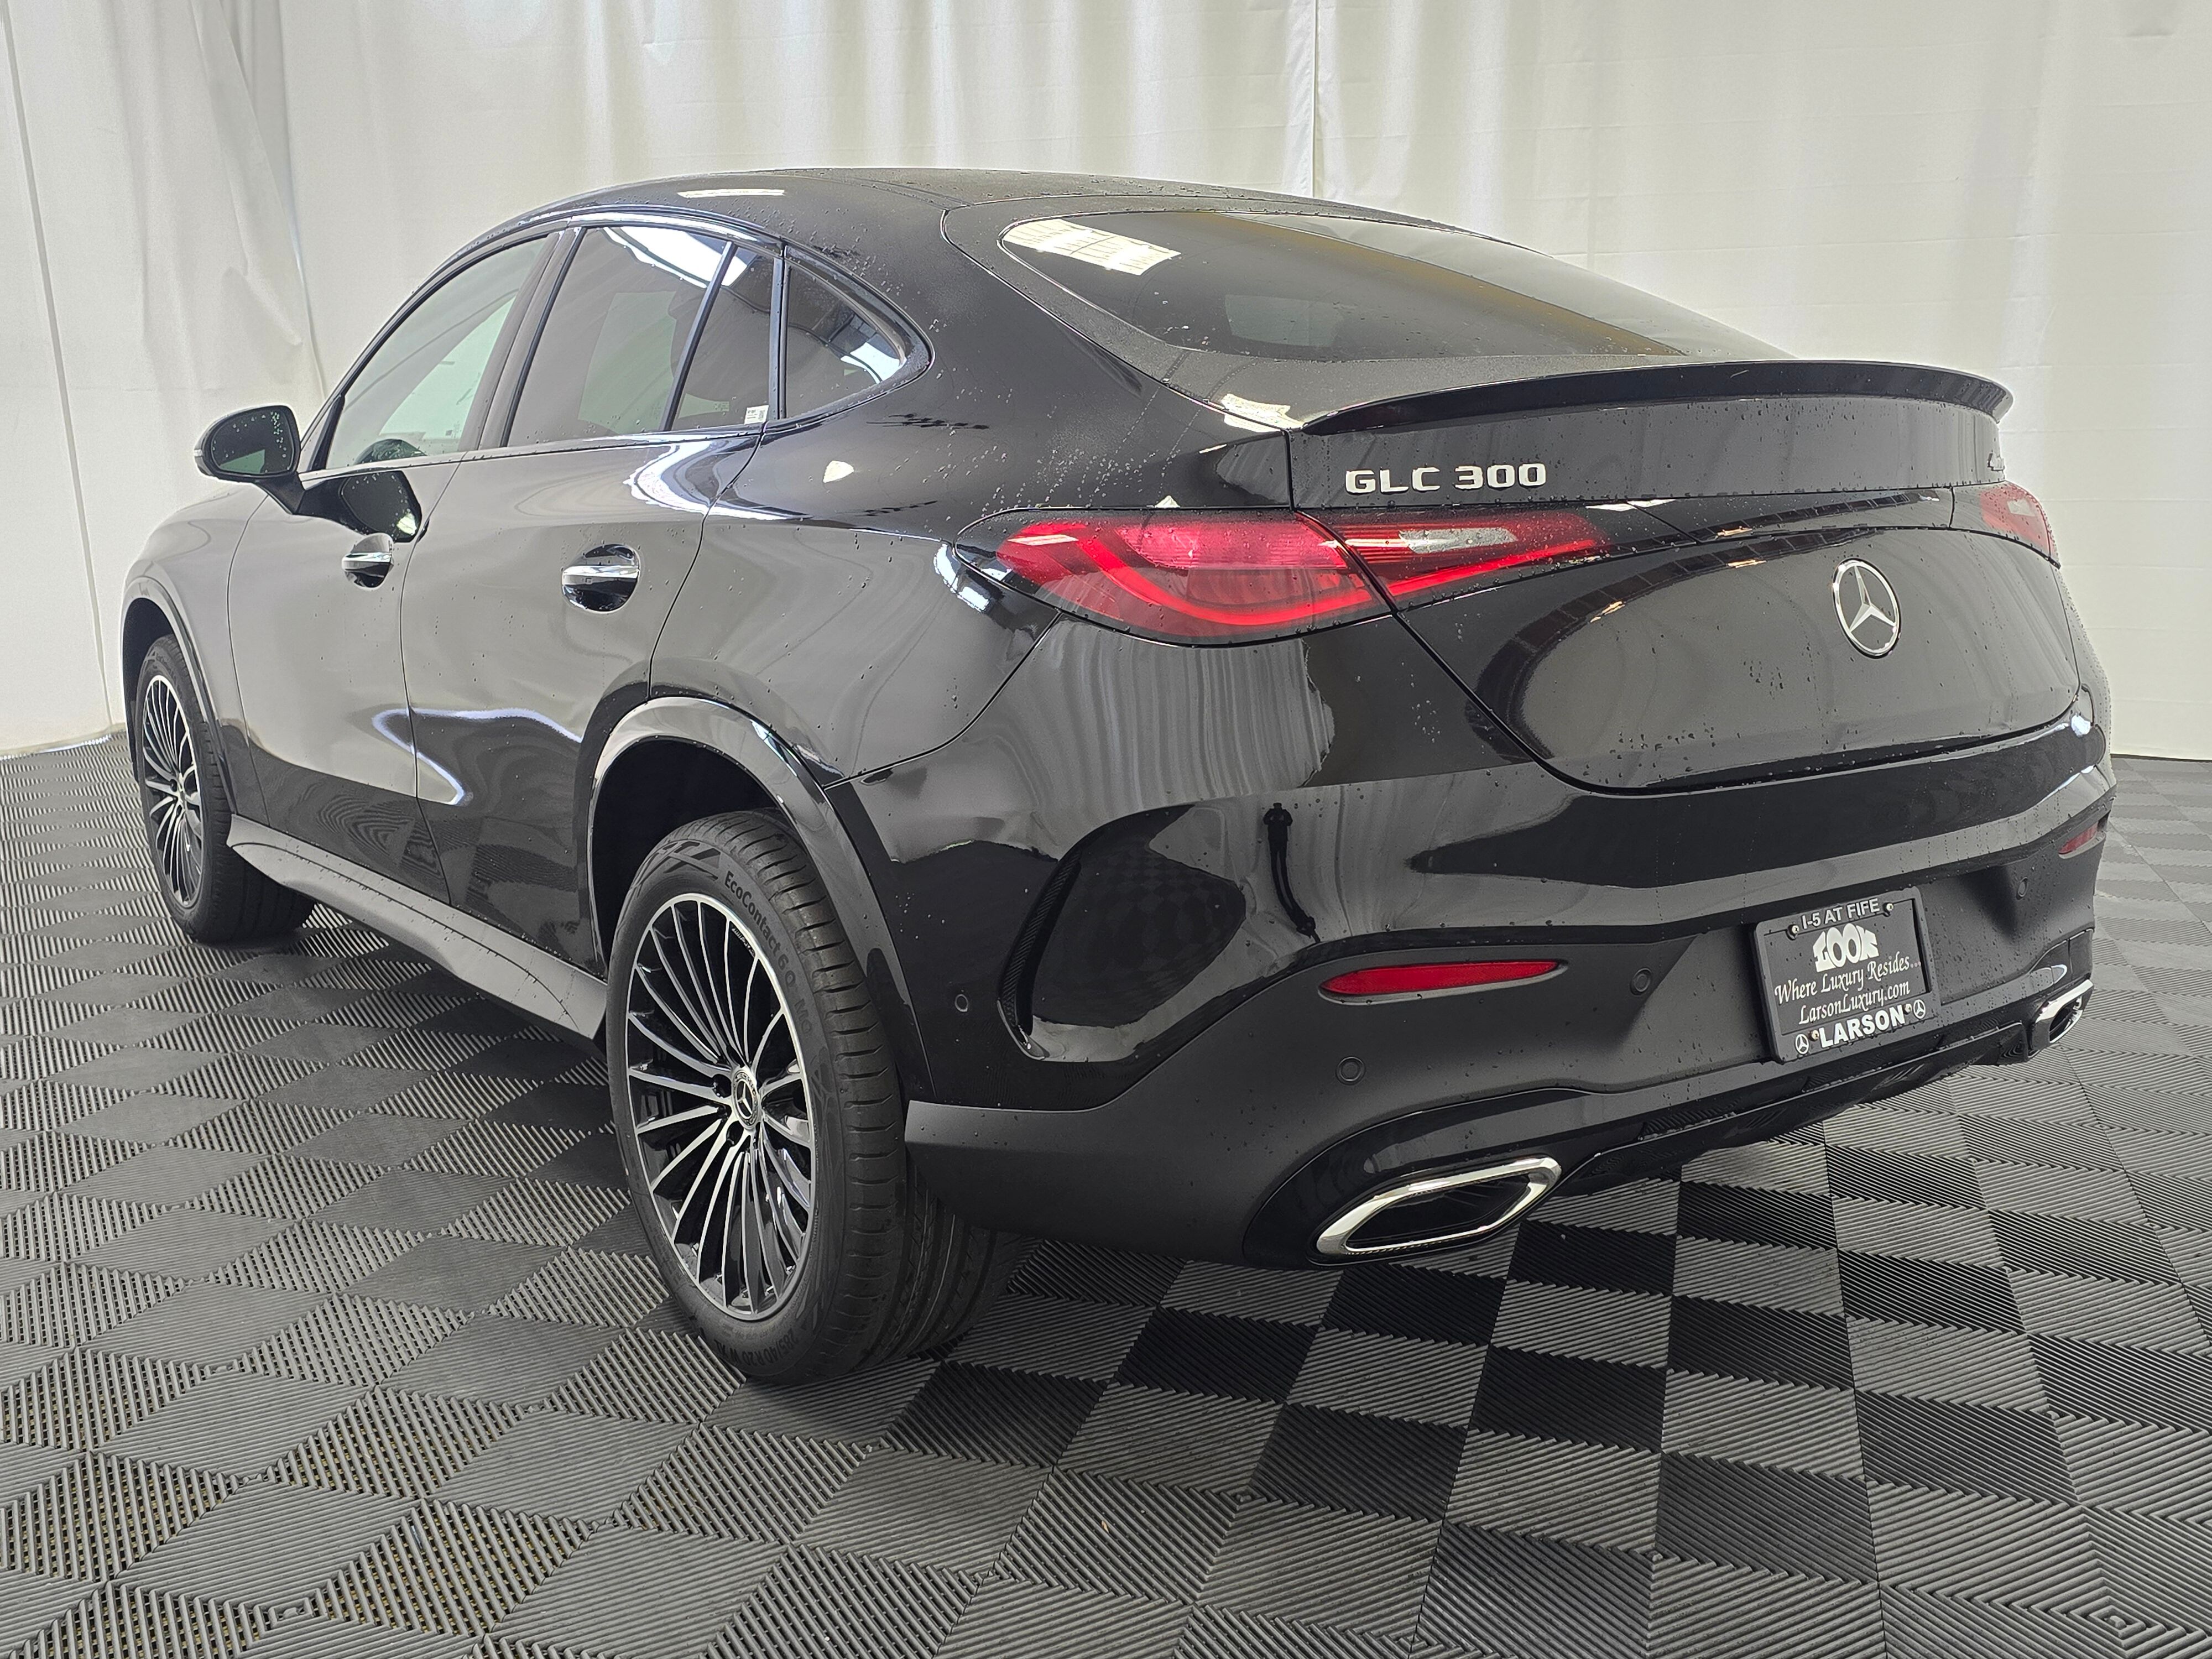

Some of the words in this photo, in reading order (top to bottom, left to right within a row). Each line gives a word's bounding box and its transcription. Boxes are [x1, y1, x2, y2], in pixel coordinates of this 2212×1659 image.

[1345, 467, 1441, 494] GLC
[1453, 463, 1546, 490] 300
[1802, 912, 1821, 930] I-5
[1825, 906, 1843, 924] AT
[1847, 898, 1880, 919] FIFE
[1812, 923, 1879, 972] LOOK
[1774, 978, 1818, 1004] Where
[1821, 968, 1864, 992] Luxury
[1798, 981, 1910, 1025] LarsonLuxury.com
[1818, 1004, 1906, 1048] LARSON
